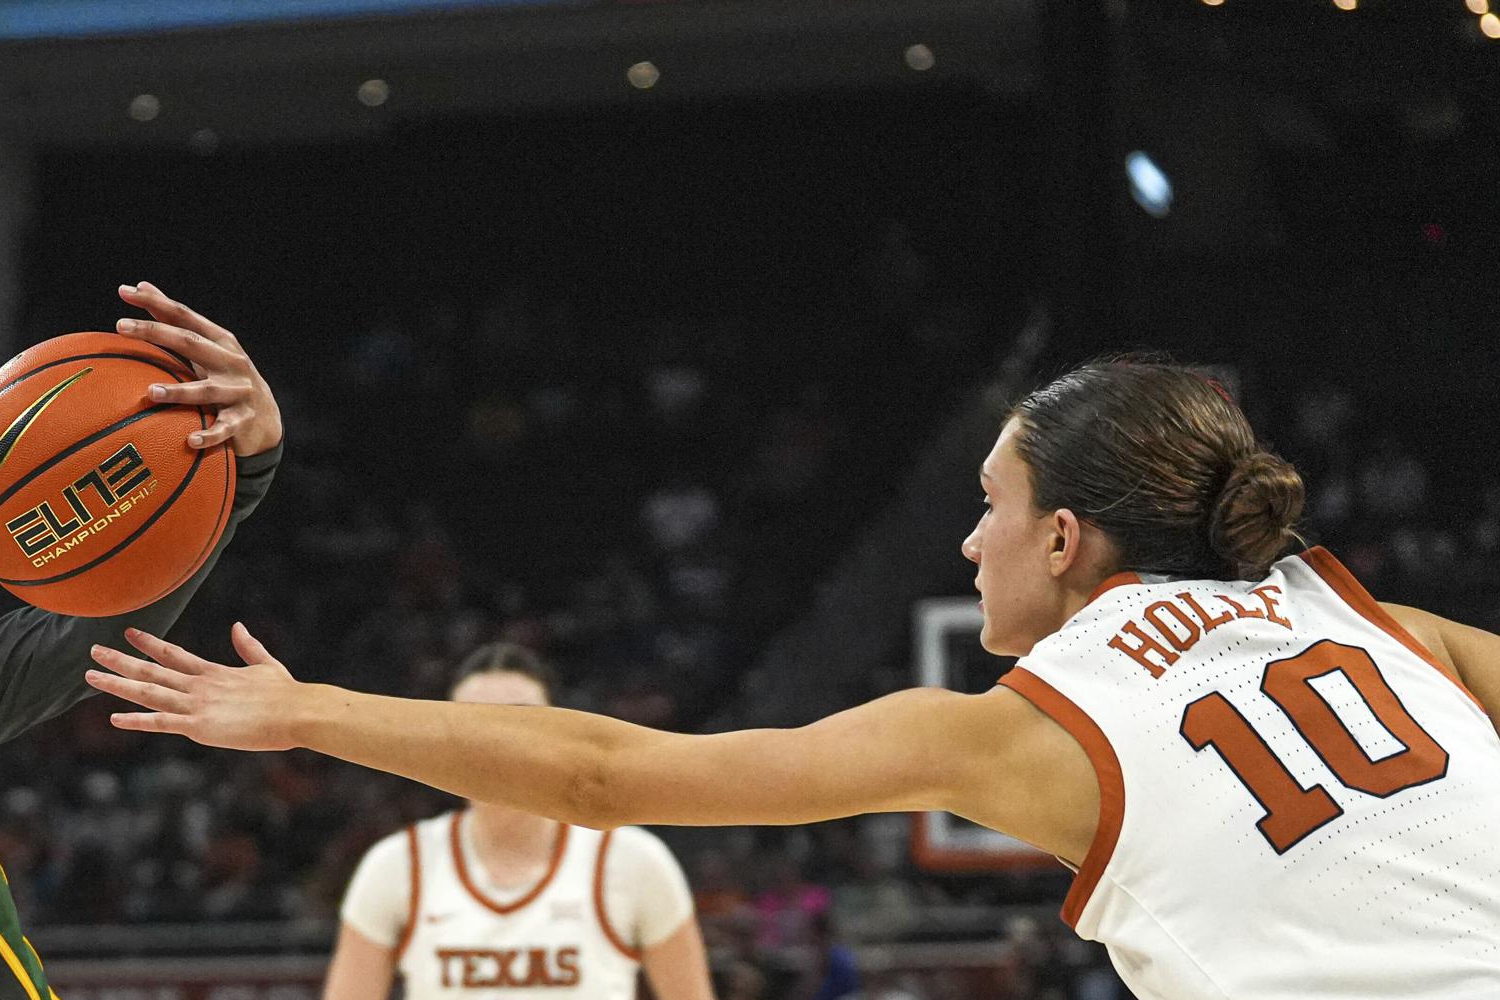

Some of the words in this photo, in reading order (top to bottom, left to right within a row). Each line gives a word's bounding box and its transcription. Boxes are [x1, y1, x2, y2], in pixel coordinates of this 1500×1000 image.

[32, 479, 159, 568] CHAMPIONSHIP
[1107, 585, 1293, 680] HOLLE
[1178, 638, 1450, 856] 10
[435, 946, 582, 989] TEXAS
